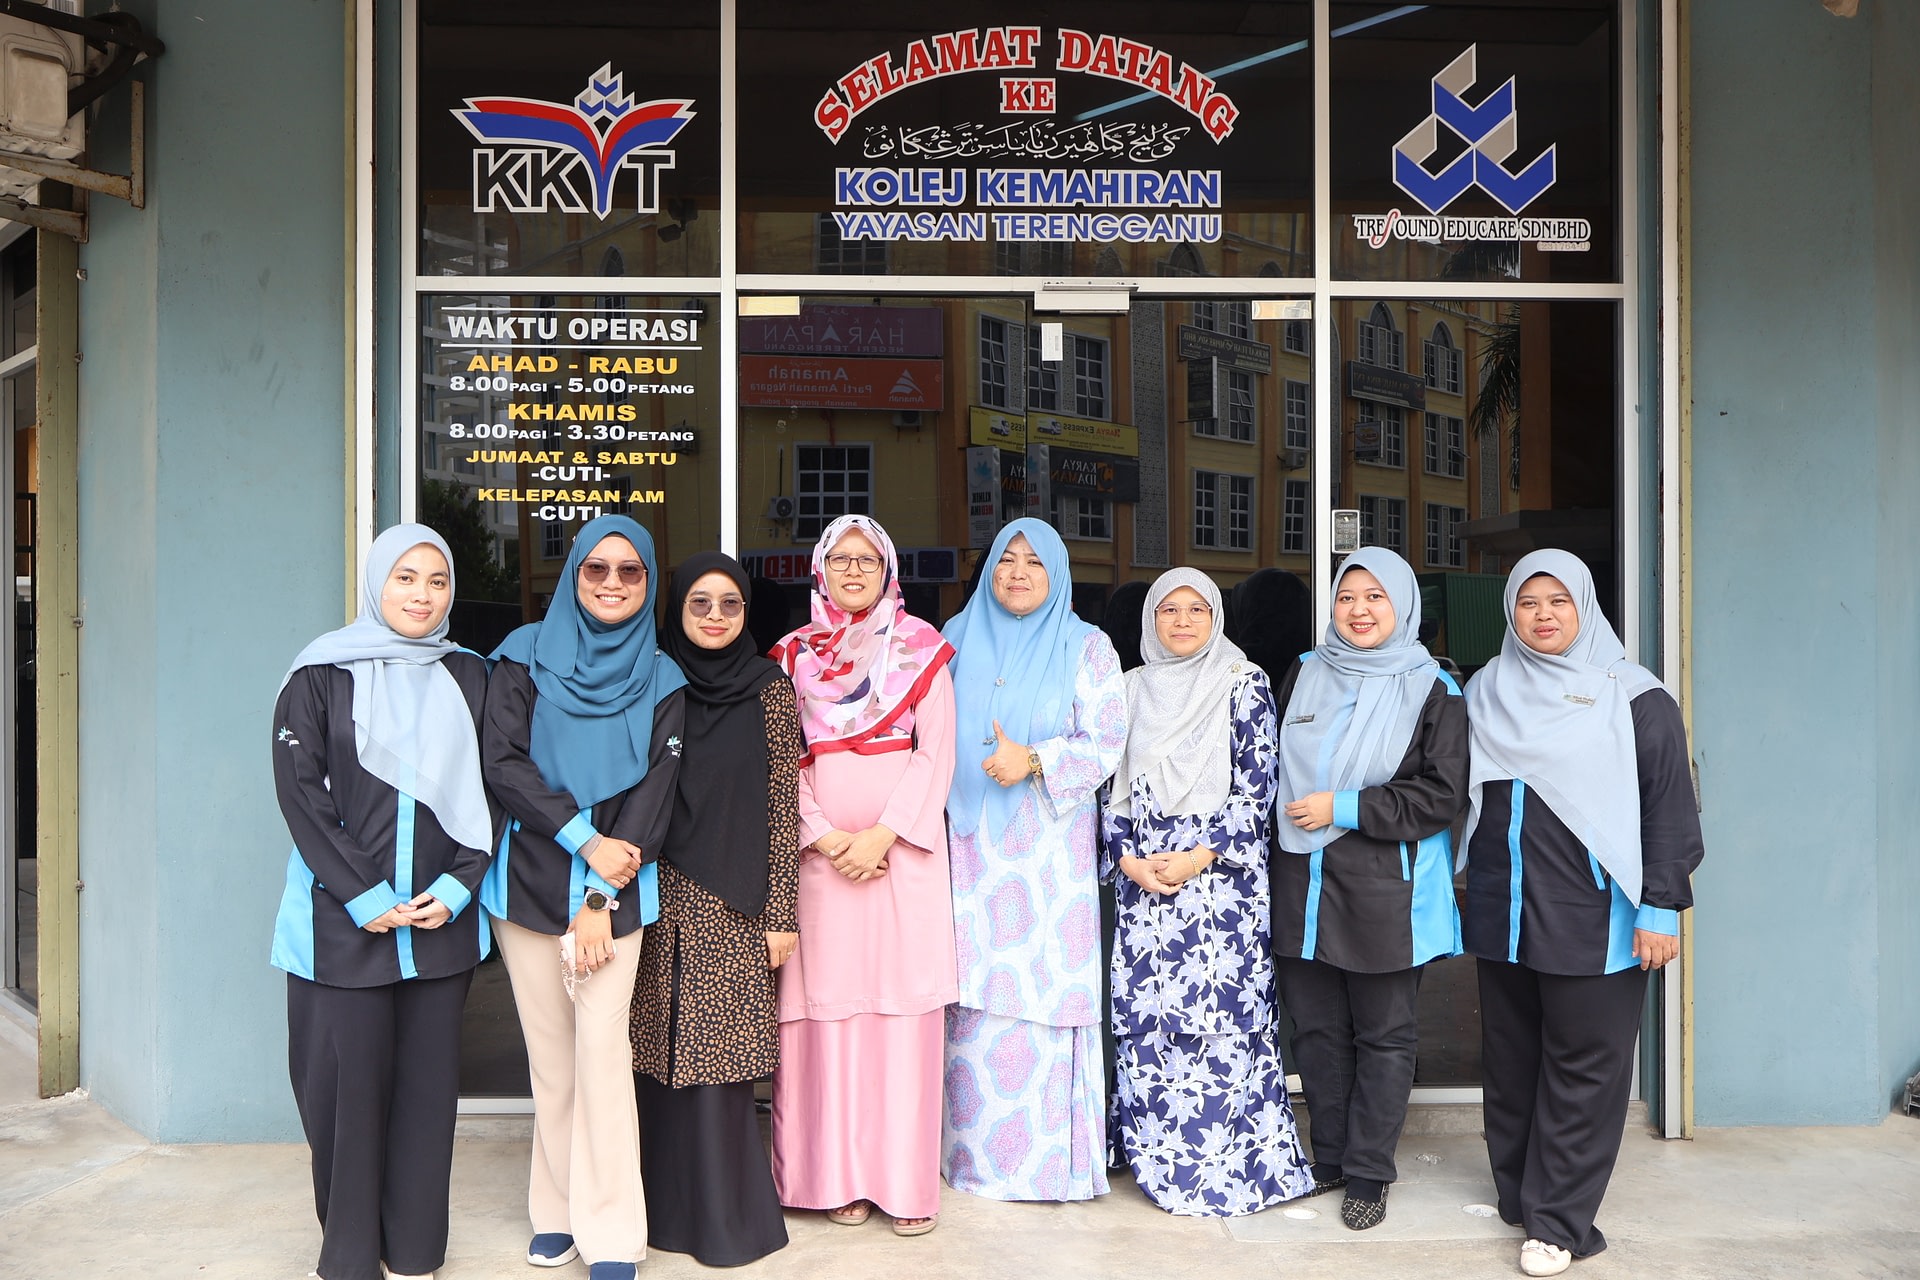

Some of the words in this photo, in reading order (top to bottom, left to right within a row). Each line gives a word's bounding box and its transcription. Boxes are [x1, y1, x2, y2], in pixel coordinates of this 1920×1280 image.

[813, 25, 1042, 145] SELAMAT
[1056, 27, 1240, 145] DATANG
[1000, 77, 1057, 114] KE
[834, 167, 967, 206] KOLEJ
[976, 169, 1222, 208] KEMAHIRAN
[831, 211, 987, 241] YAYASAN
[992, 212, 1223, 243] TERENGGANU
[1447, 219, 1518, 239] EDUCARE
[448, 316, 558, 340] WAKTU
[568, 318, 698, 342] OPERASI
[467, 355, 559, 373] AHAD
[589, 357, 679, 375] RABU
[508, 403, 638, 422] KHAMIS
[466, 450, 564, 464] JUMAAT
[572, 451, 589, 465] &
[597, 452, 677, 466] SABTU
[531, 466, 611, 482] -CUTI-
[478, 488, 620, 503] KELEPASAN
[628, 490, 665, 504] AM
